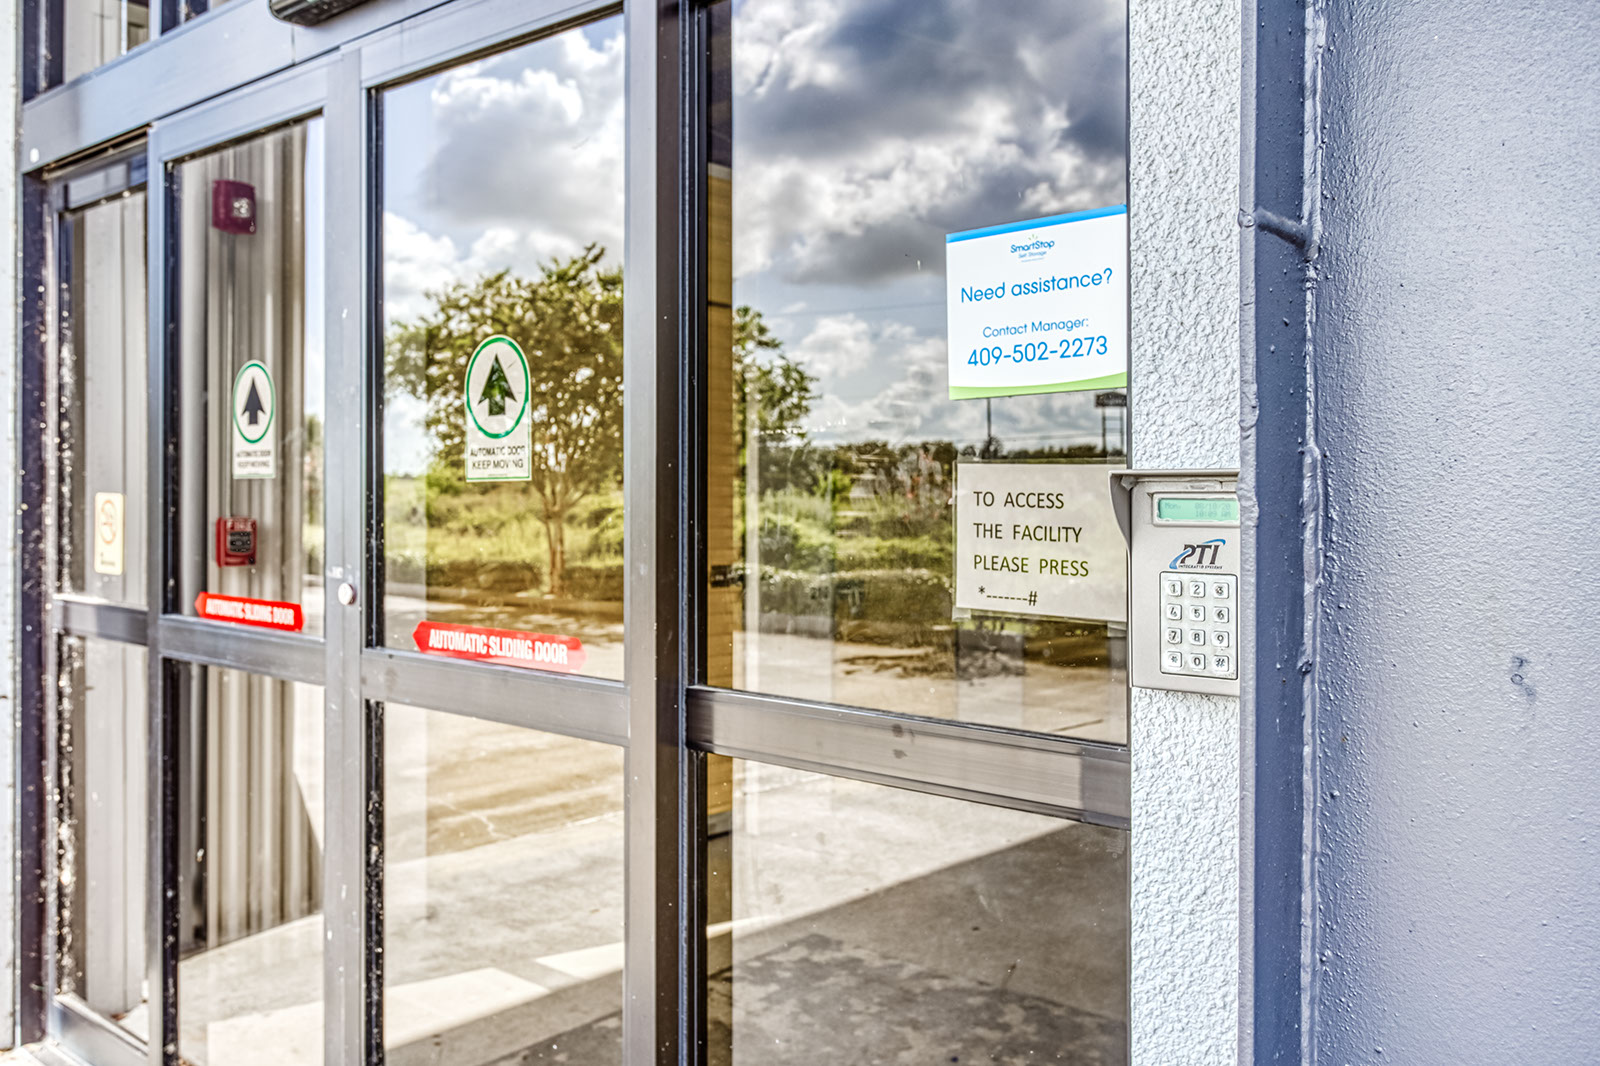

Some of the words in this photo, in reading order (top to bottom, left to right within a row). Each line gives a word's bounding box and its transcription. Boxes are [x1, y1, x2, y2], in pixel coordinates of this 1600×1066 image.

[1010, 239, 1055, 254] SmartStop
[961, 282, 1005, 303] Need
[1011, 267, 1113, 297] assistance?
[982, 322, 1028, 338] Contact
[1031, 318, 1089, 336] Manager:
[967, 335, 1108, 367] 409-502-2273
[472, 461, 491, 470] KEEP
[973, 491, 995, 507] TO
[1004, 492, 1064, 510] ACCESS
[973, 523, 1003, 540] THE
[1013, 524, 1082, 543] FACILITY
[1179, 543, 1221, 564] PTI
[973, 554, 1029, 574] PLEASE
[1039, 558, 1089, 577] PRESS
[1170, 584, 1178, 593] 1
[1193, 584, 1201, 595] 2
[1193, 607, 1201, 618] 5
[1217, 609, 1225, 620] 6
[428, 628, 488, 654] AUTOMATIC
[488, 635, 533, 660] SLIDING
[534, 641, 568, 665] DOOR
[1170, 630, 1178, 641] 7
[1193, 631, 1201, 642] 8
[1217, 634, 1225, 645] 9
[1193, 656, 1201, 667] 0
